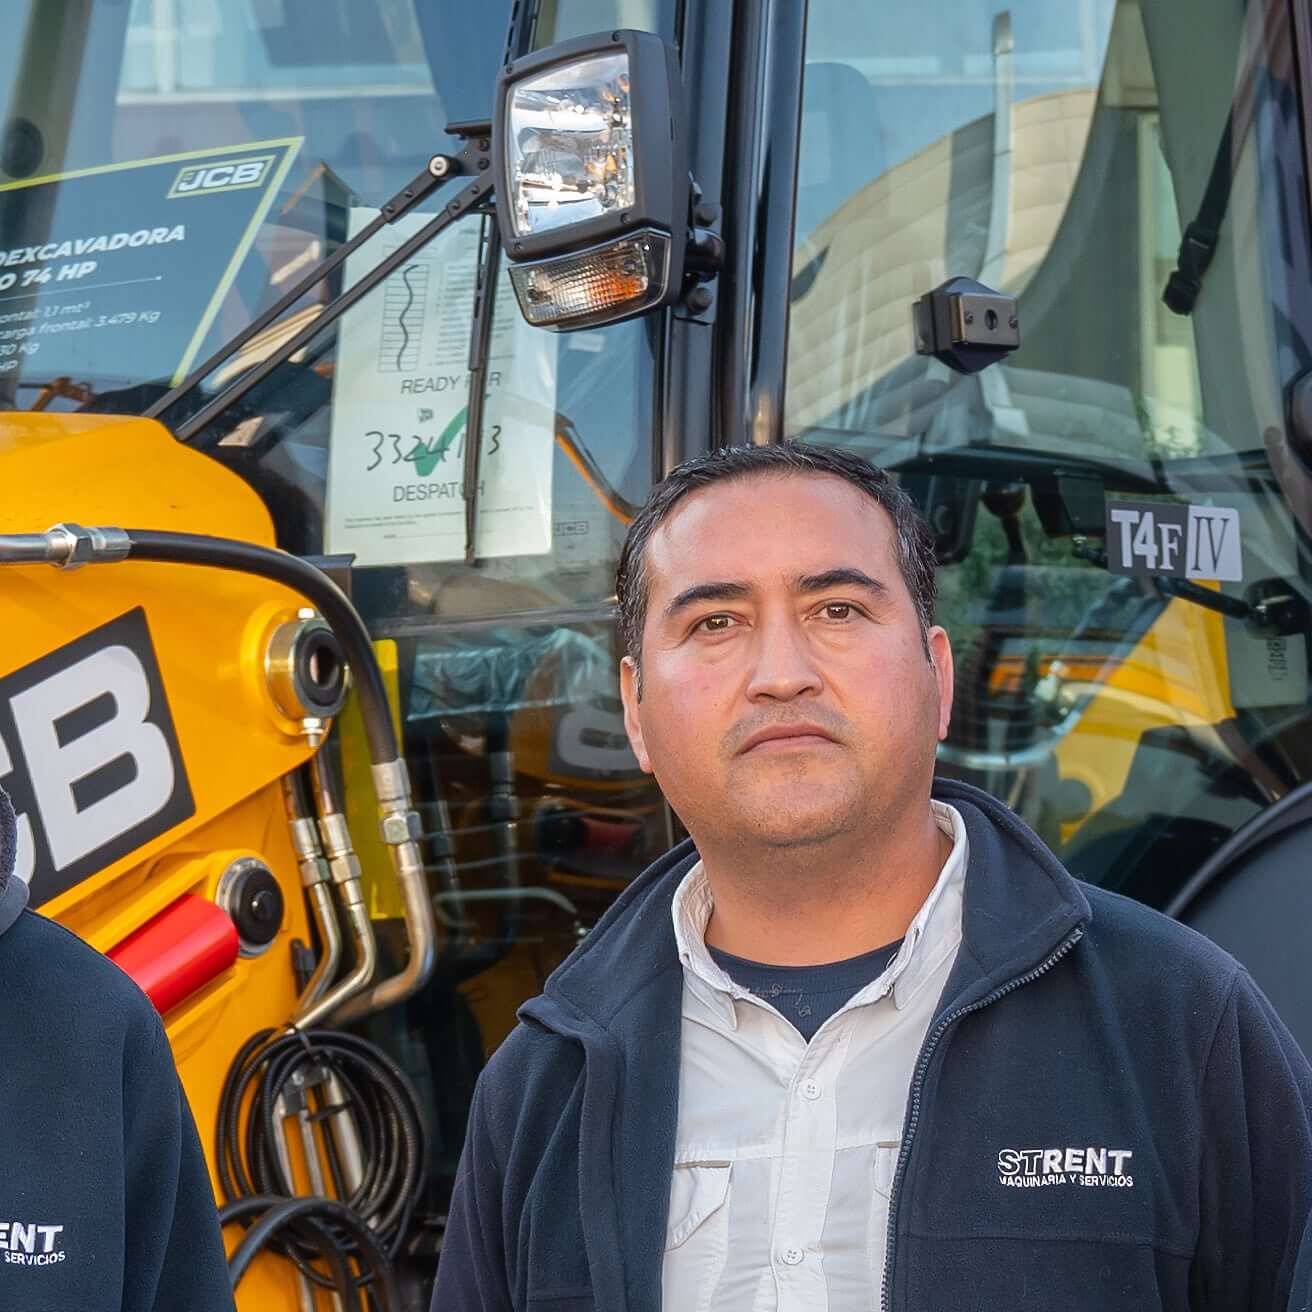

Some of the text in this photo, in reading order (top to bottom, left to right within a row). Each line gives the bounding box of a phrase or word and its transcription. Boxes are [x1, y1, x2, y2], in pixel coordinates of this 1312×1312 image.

[177, 161, 265, 191] JCB
[20, 266, 52, 286] 74
[57, 260, 98, 281] HP
[400, 376, 461, 394] READY
[998, 1148, 1133, 1175] STRENT
[999, 1174, 1134, 1187] MAQUINARIA Y SERVICIOS
[4, 1251, 66, 1266] SERVICIOS
